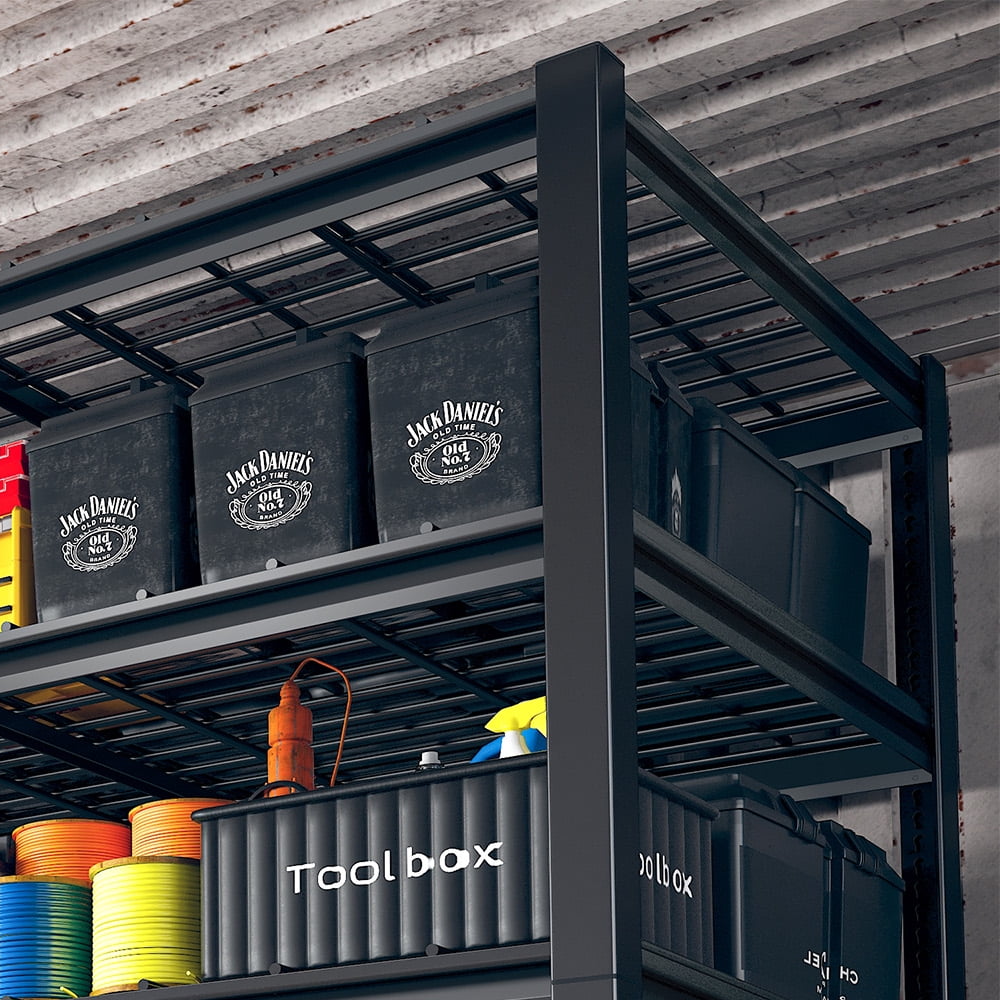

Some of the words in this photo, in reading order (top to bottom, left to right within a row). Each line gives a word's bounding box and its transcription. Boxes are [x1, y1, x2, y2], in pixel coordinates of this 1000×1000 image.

[406, 410, 444, 447] JACK
[433, 427, 451, 440] OLD
[454, 423, 476, 431] TIME
[443, 440, 467, 456] Old
[226, 458, 260, 494] JACK
[443, 464, 469, 474] BRAND
[250, 475, 267, 487] OLD
[259, 488, 281, 503] Old
[59, 503, 90, 537] JACK
[260, 511, 283, 520] BRAND
[81, 520, 97, 531] OLD
[89, 532, 110, 546] Old
[90, 554, 110, 562] BRAND
[286, 842, 504, 894] Toolbox
